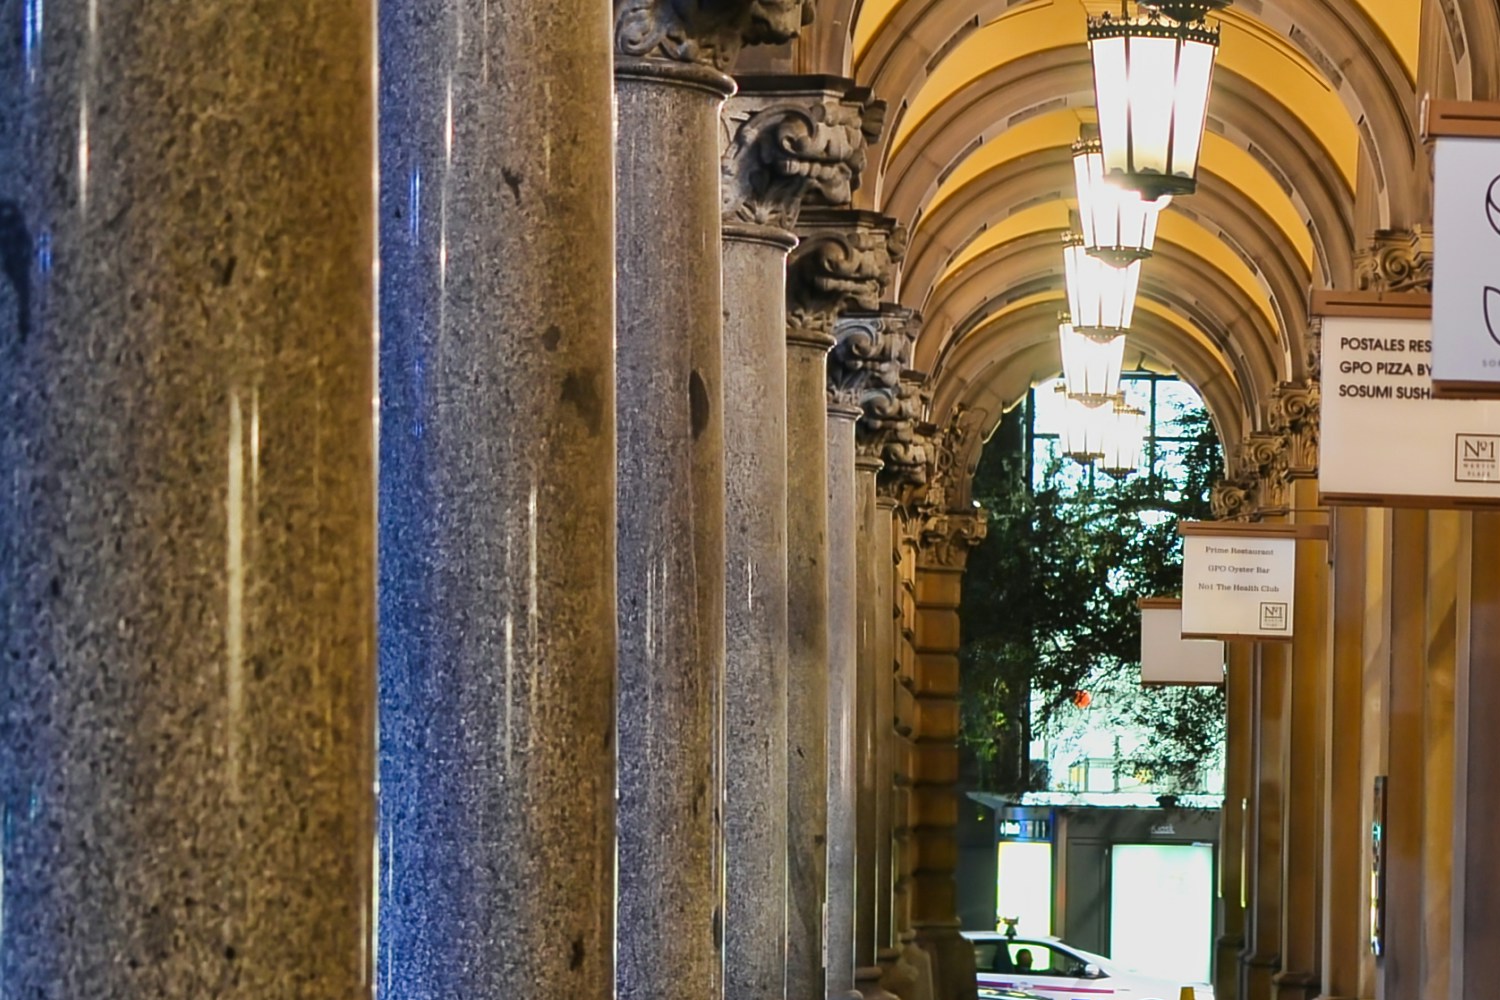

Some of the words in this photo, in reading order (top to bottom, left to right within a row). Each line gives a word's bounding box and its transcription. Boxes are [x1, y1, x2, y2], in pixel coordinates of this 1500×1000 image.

[1340, 337, 1405, 351] POSTALES
[1339, 361, 1373, 375] GPO
[1376, 363, 1413, 377] PIZZA
[1417, 366, 1432, 377] BY
[1338, 384, 1393, 399] SOSUMI
[1396, 387, 1433, 400] SUSH
[1205, 546, 1229, 554] Prime
[1231, 547, 1274, 556] Restaurant
[1208, 564, 1227, 573] GPO
[1228, 566, 1254, 574] Oyster
[1216, 583, 1232, 591] The
[1233, 584, 1259, 592] Health
[1260, 585, 1280, 593] Club
